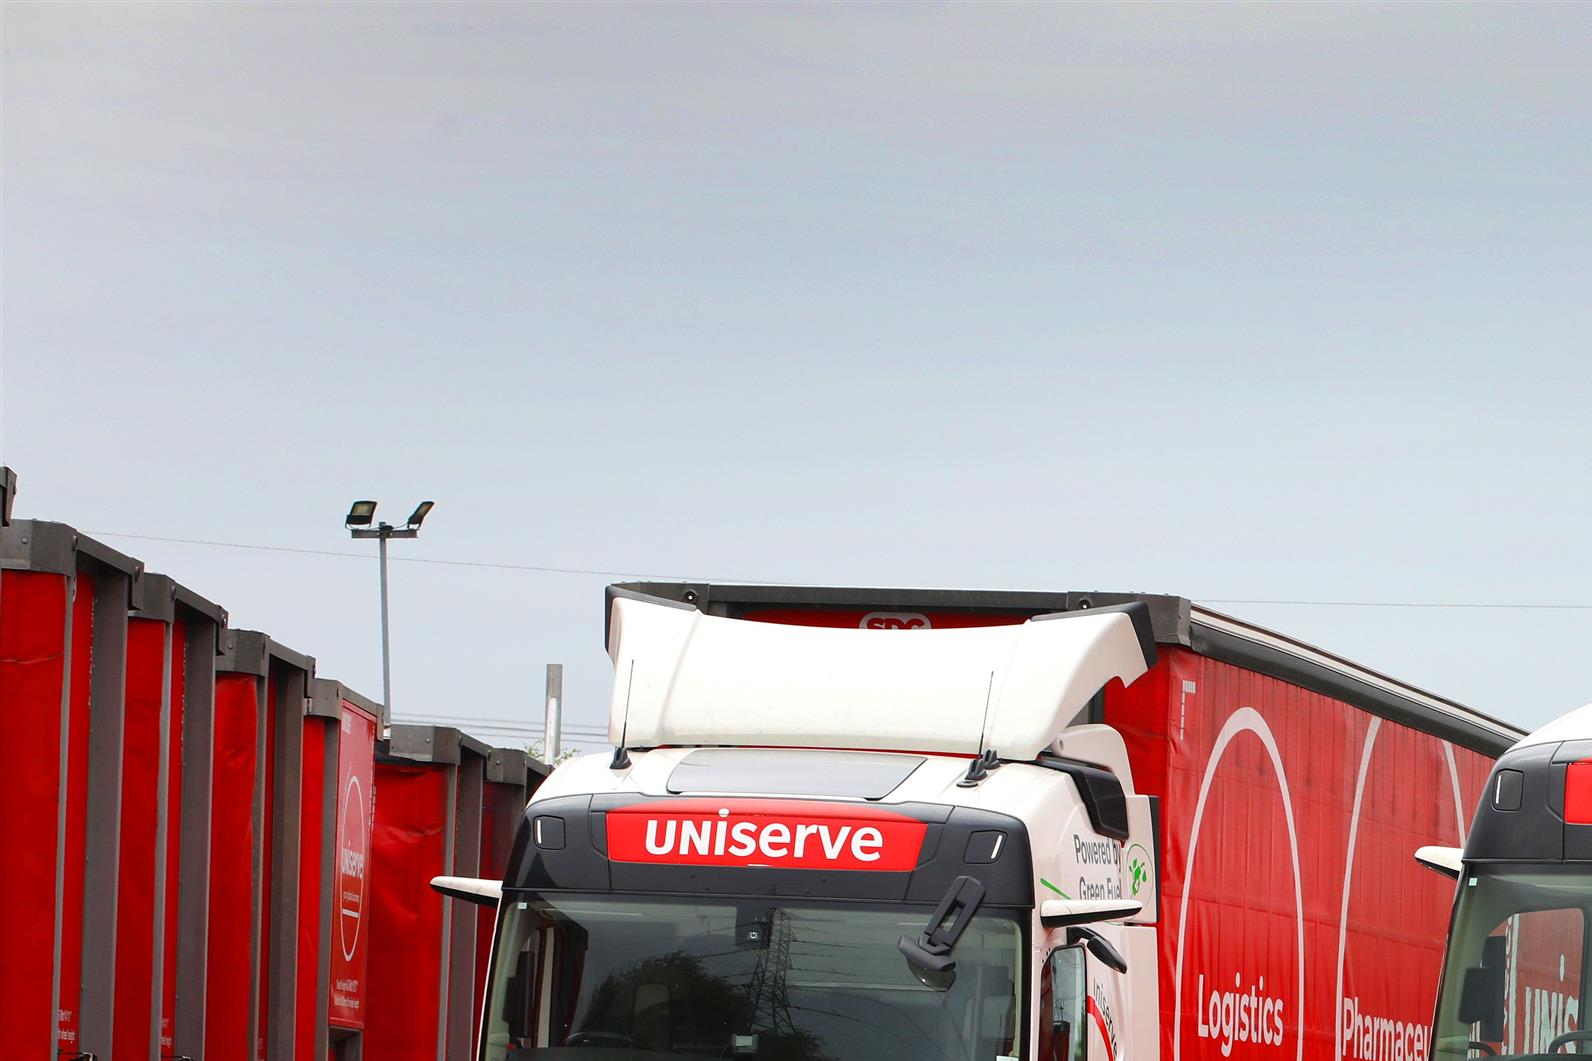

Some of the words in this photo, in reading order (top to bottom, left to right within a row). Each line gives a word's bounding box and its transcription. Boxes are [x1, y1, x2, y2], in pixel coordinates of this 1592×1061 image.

[1073, 834, 1112, 865] Powered
[1079, 876, 1105, 900] Green
[1197, 972, 1284, 1057] Logistics
